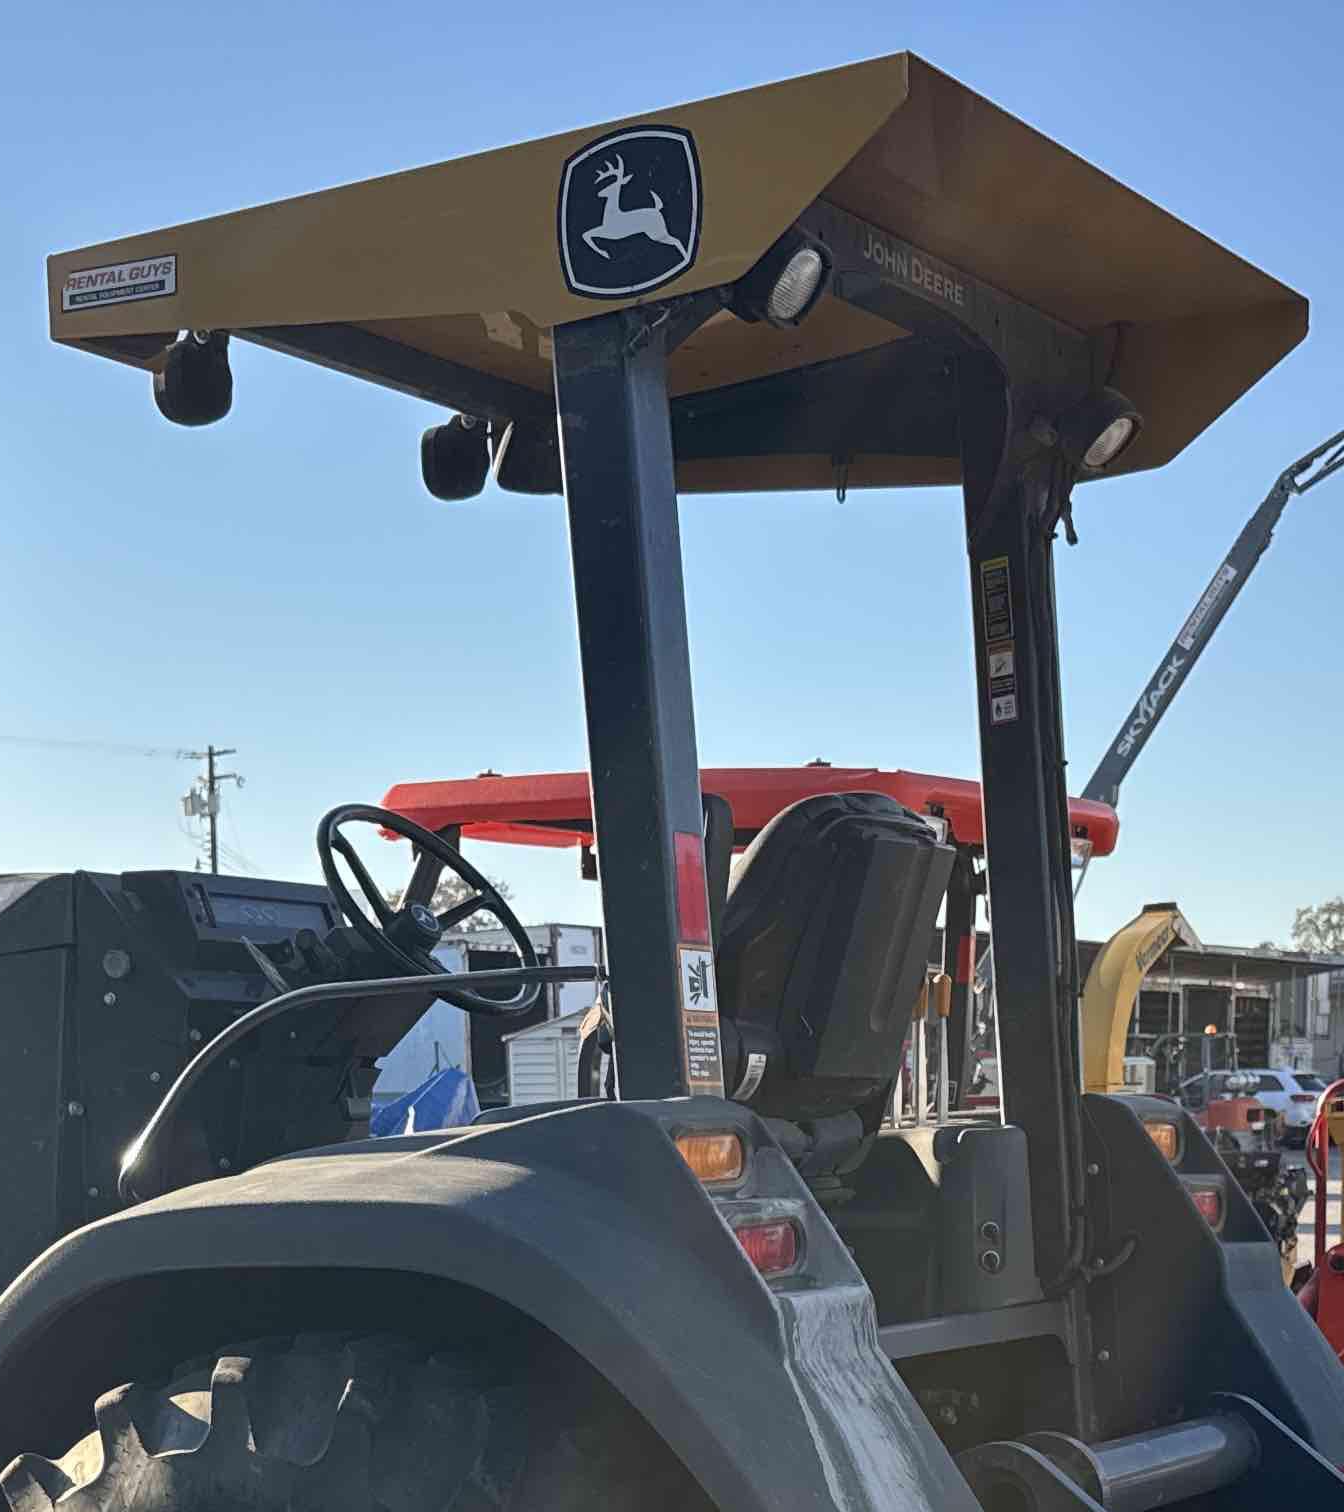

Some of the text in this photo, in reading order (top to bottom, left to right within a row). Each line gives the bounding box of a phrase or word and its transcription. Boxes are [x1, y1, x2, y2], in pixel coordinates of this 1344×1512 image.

[65, 261, 173, 291] RENTAL GUYS
[864, 232, 965, 306] JOHN DEERE
[1117, 655, 1185, 757] SKYJACK
